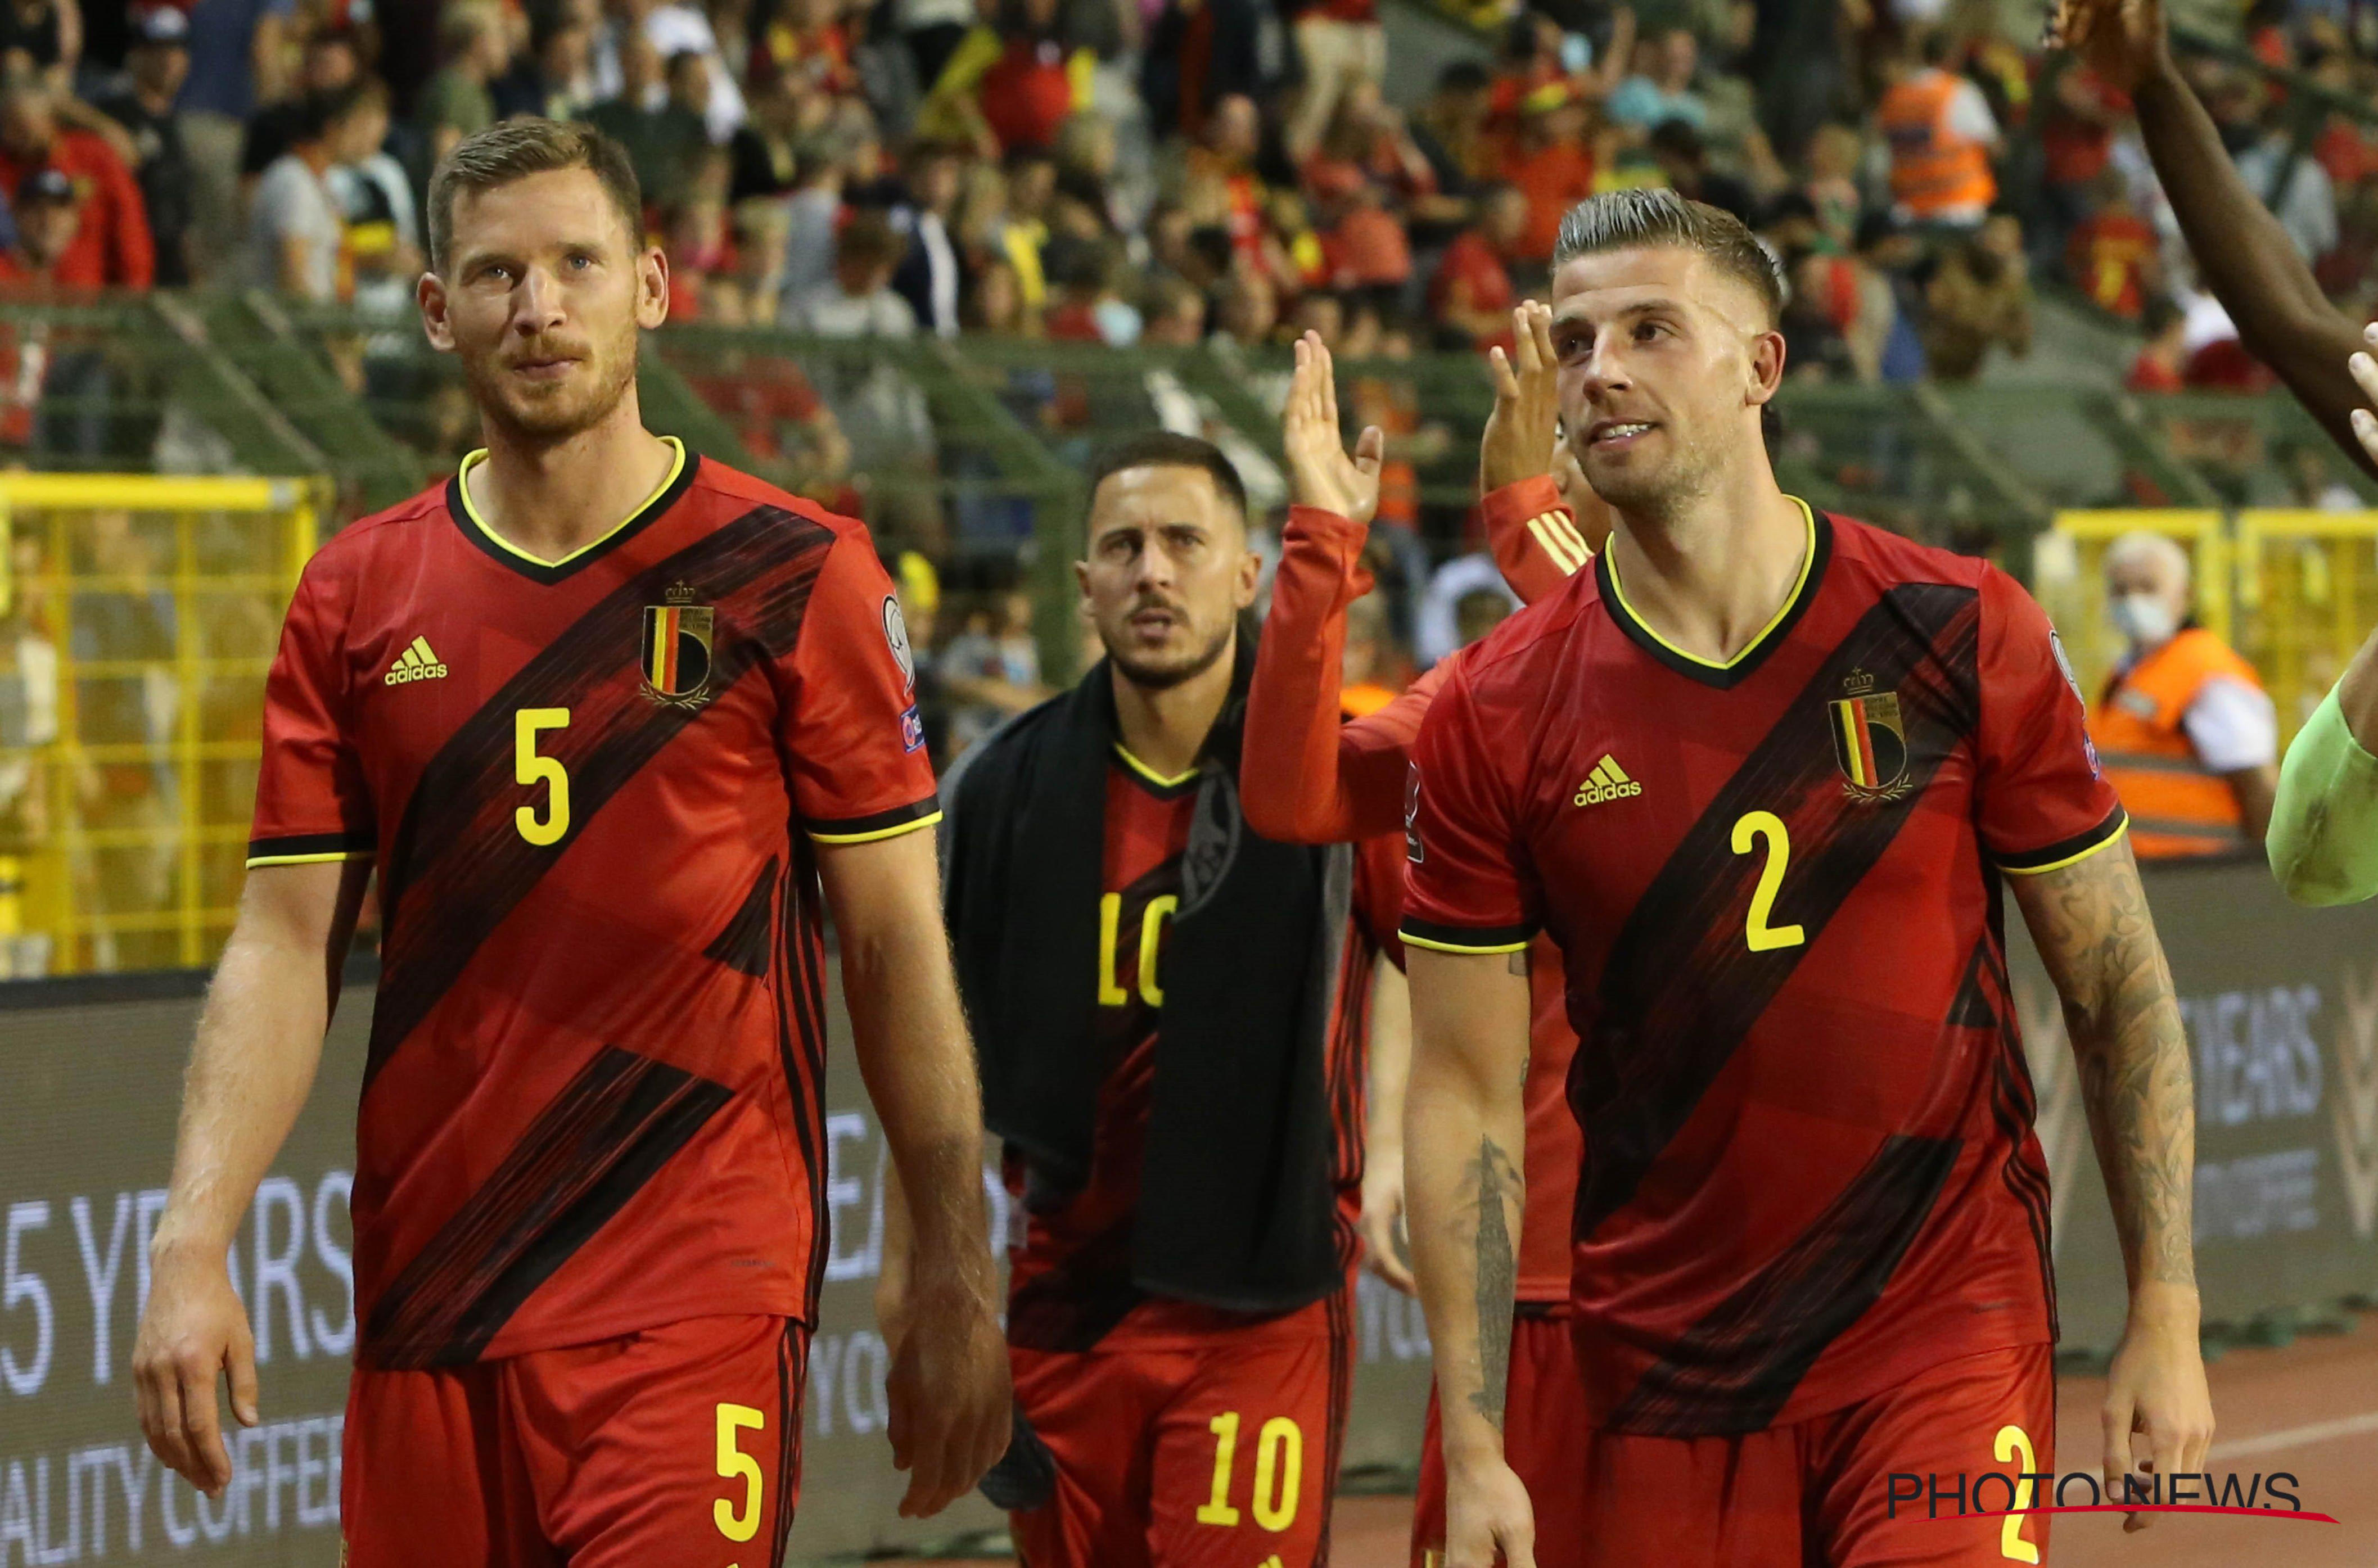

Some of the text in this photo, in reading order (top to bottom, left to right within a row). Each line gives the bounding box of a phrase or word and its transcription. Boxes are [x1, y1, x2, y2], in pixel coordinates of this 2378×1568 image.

[385, 662, 448, 685] adidas
[515, 707, 570, 846] 5
[1574, 780, 1642, 807] adidas
[1731, 810, 1805, 952] 2
[70, 1169, 356, 1385] YRS
[713, 1402, 764, 1542] 5
[1195, 1411, 1303, 1532] 10
[1993, 1425, 2039, 1565] 2
